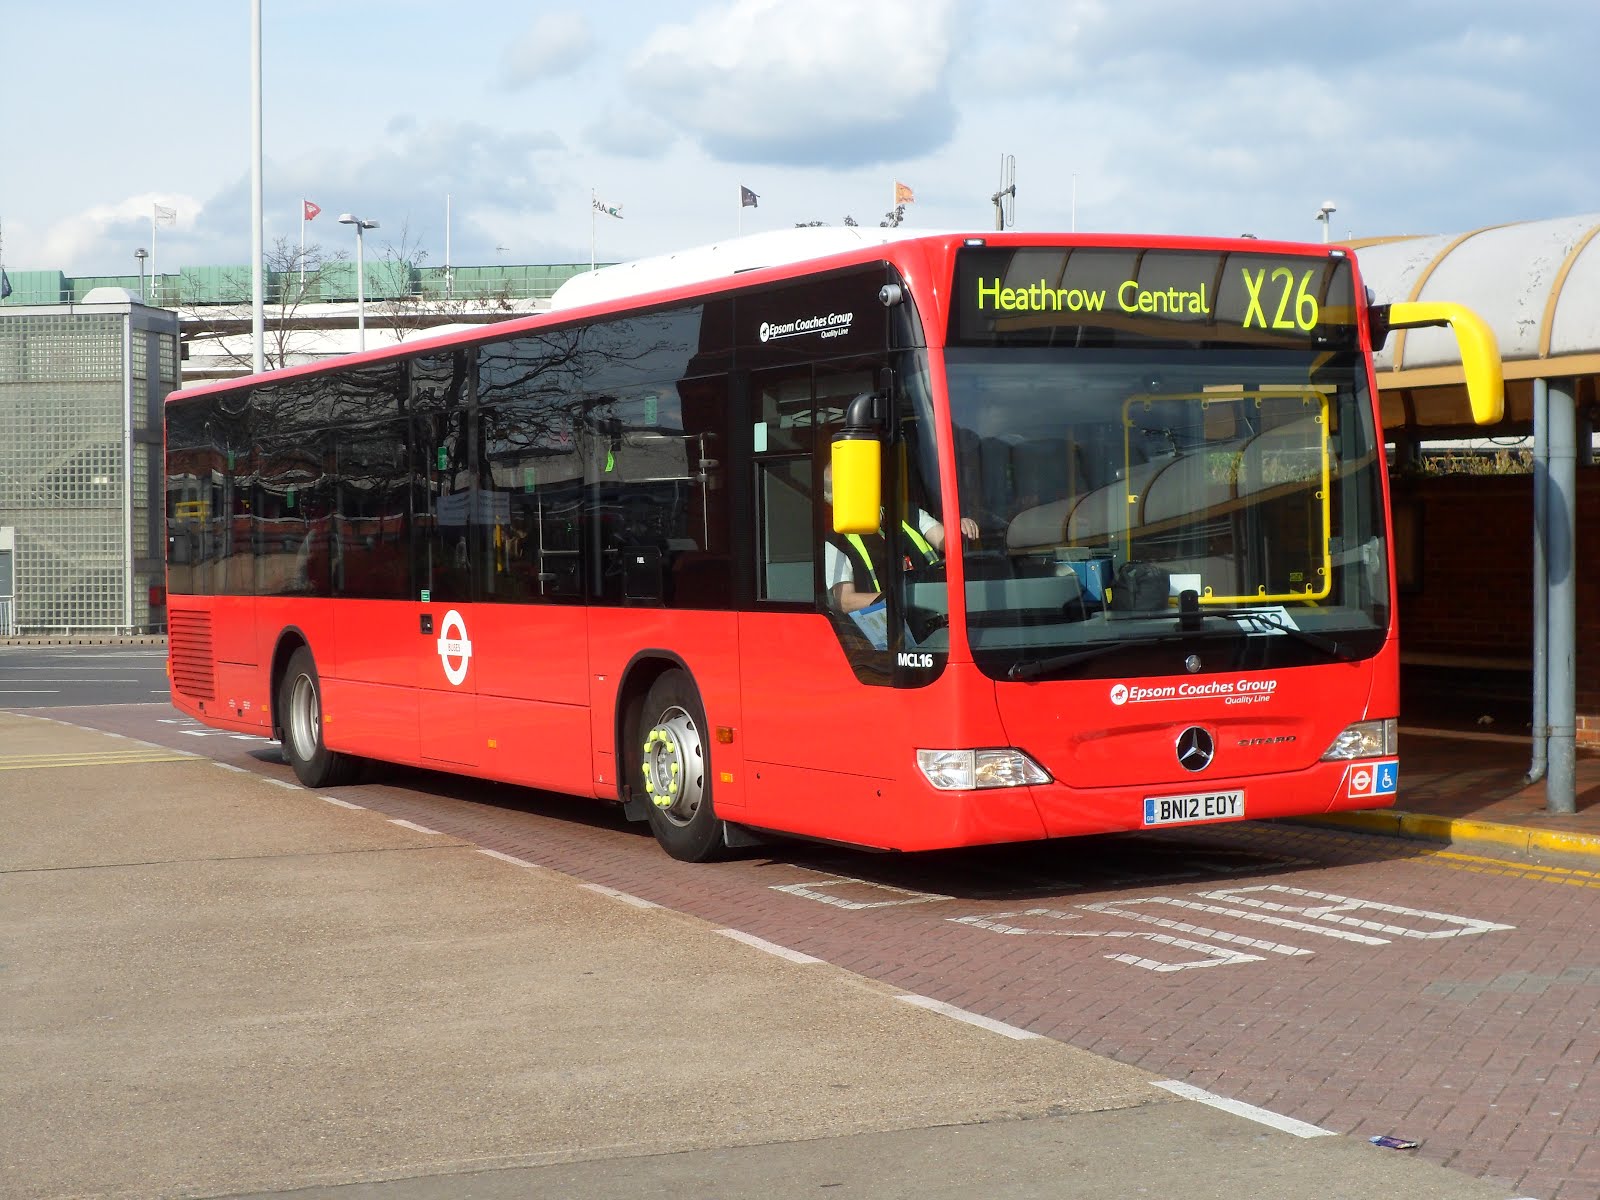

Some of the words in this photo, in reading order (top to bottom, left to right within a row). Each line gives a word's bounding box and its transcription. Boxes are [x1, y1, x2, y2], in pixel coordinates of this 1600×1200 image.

[978, 277, 1106, 311] Heathrow
[1118, 280, 1210, 313] Central
[1242, 267, 1319, 331] X26
[769, 322, 794, 337] Epsom
[795, 315, 827, 331] Coaches
[828, 312, 853, 326] Group
[898, 653, 933, 668] MCL16
[1129, 686, 1176, 701] Epsom
[1178, 680, 1234, 696] Coaches
[1236, 679, 1277, 692] Group
[1225, 695, 1253, 705] Quality
[1254, 694, 1270, 703] Line
[1237, 735, 1297, 747] CITARO
[1160, 798, 1199, 820] BN12
[1205, 795, 1238, 816] EOY
